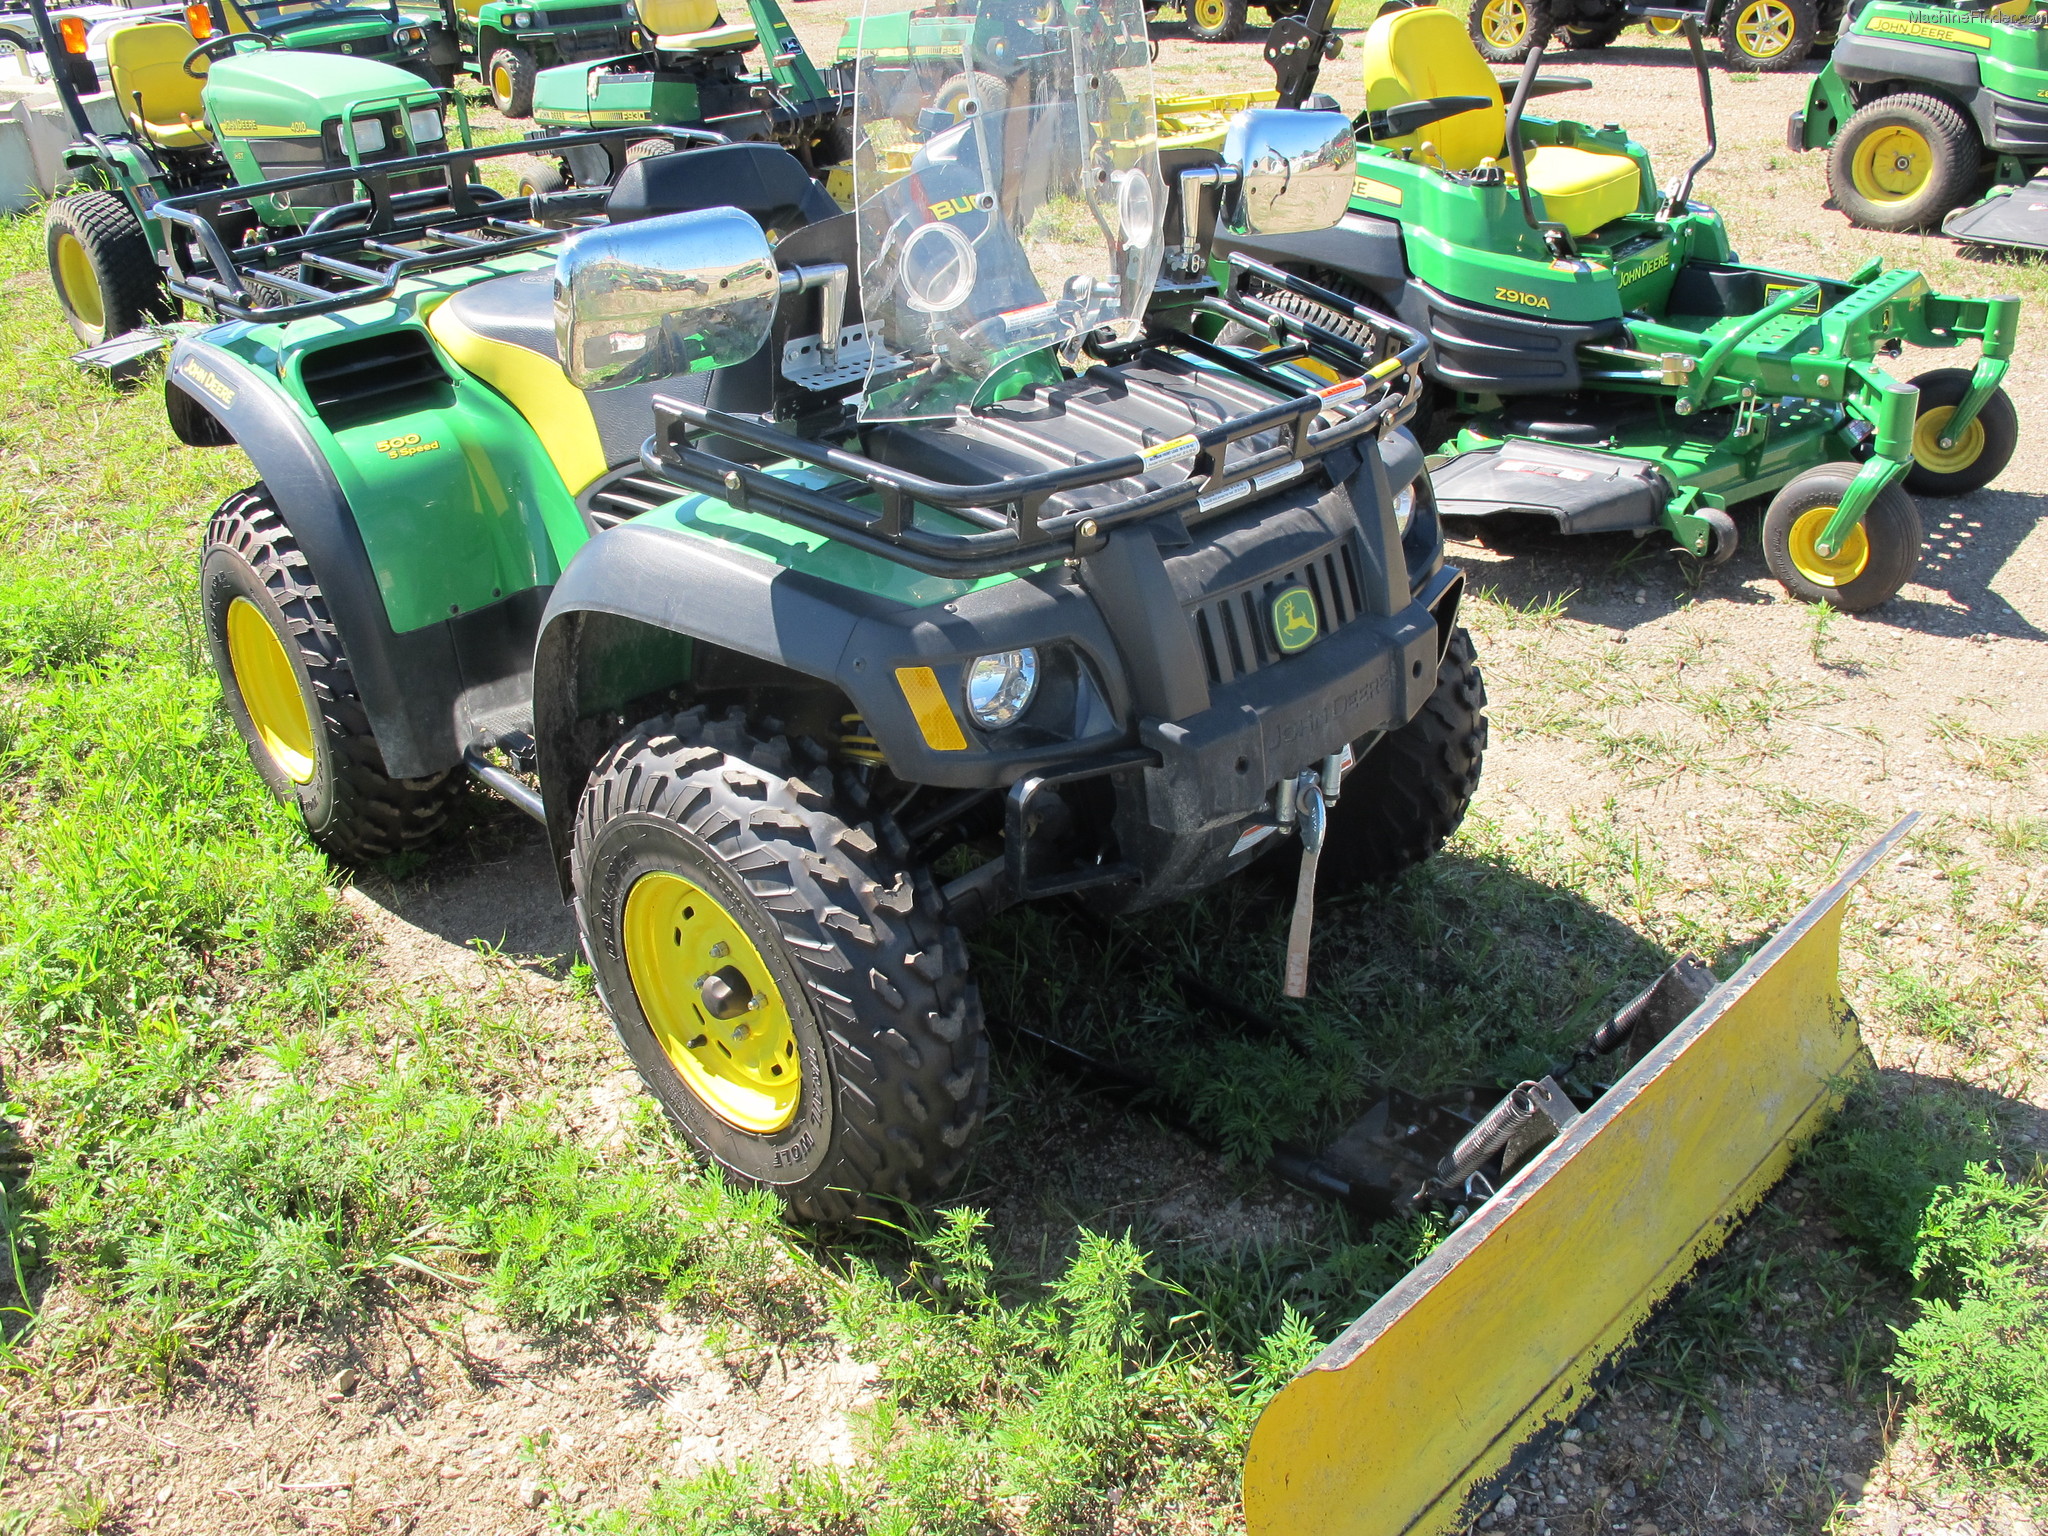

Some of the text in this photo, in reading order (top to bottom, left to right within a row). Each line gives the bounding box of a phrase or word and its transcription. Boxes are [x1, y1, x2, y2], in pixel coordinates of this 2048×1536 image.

[1874, 19, 1954, 40] JOHN DEERE
[1617, 265, 1641, 289] JOHN
[1641, 253, 1669, 277] DEERE
[1495, 287, 1550, 310] Z910A
[183, 358, 236, 405] JOHN DEERE
[376, 433, 421, 453] 500
[399, 440, 440, 457] Speed
[773, 1130, 814, 1168] WOLF
